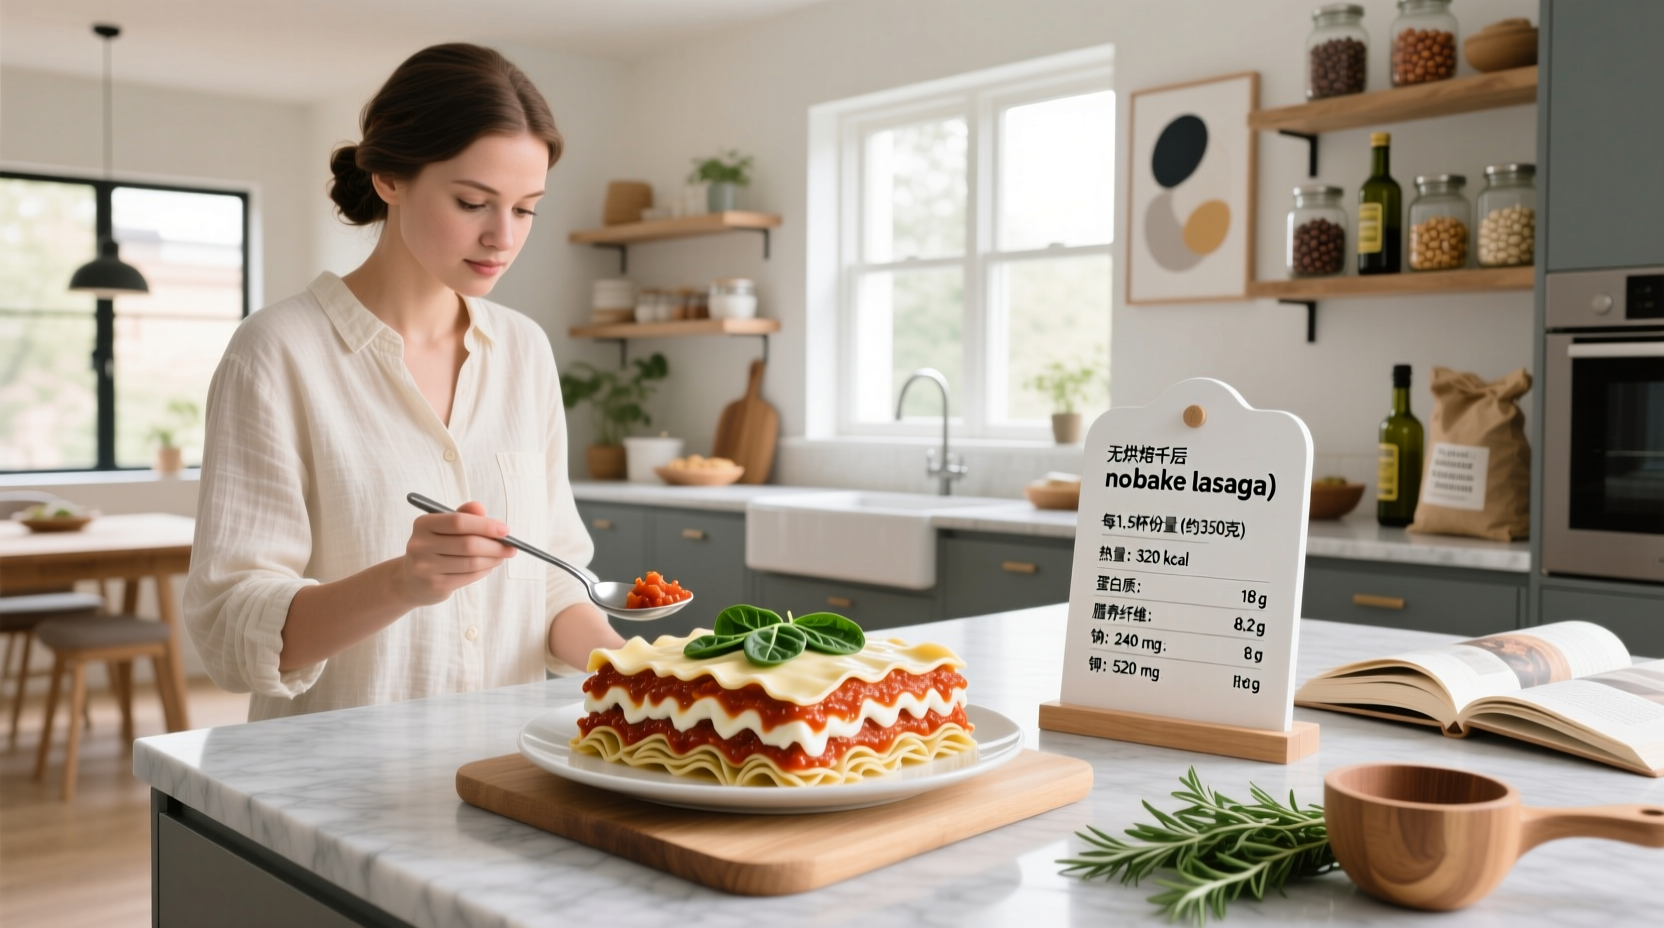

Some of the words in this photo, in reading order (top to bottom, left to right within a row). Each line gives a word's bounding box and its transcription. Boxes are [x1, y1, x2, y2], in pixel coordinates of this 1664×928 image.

[1105, 467, 1187, 491] nobake
[1192, 470, 1276, 501] lasaga)
[1135, 549, 1161, 564] 320
[1163, 549, 1190, 566] kcal
[1114, 632, 1139, 649] 240
[1112, 659, 1137, 675] 520
[1140, 666, 1160, 682] mg
